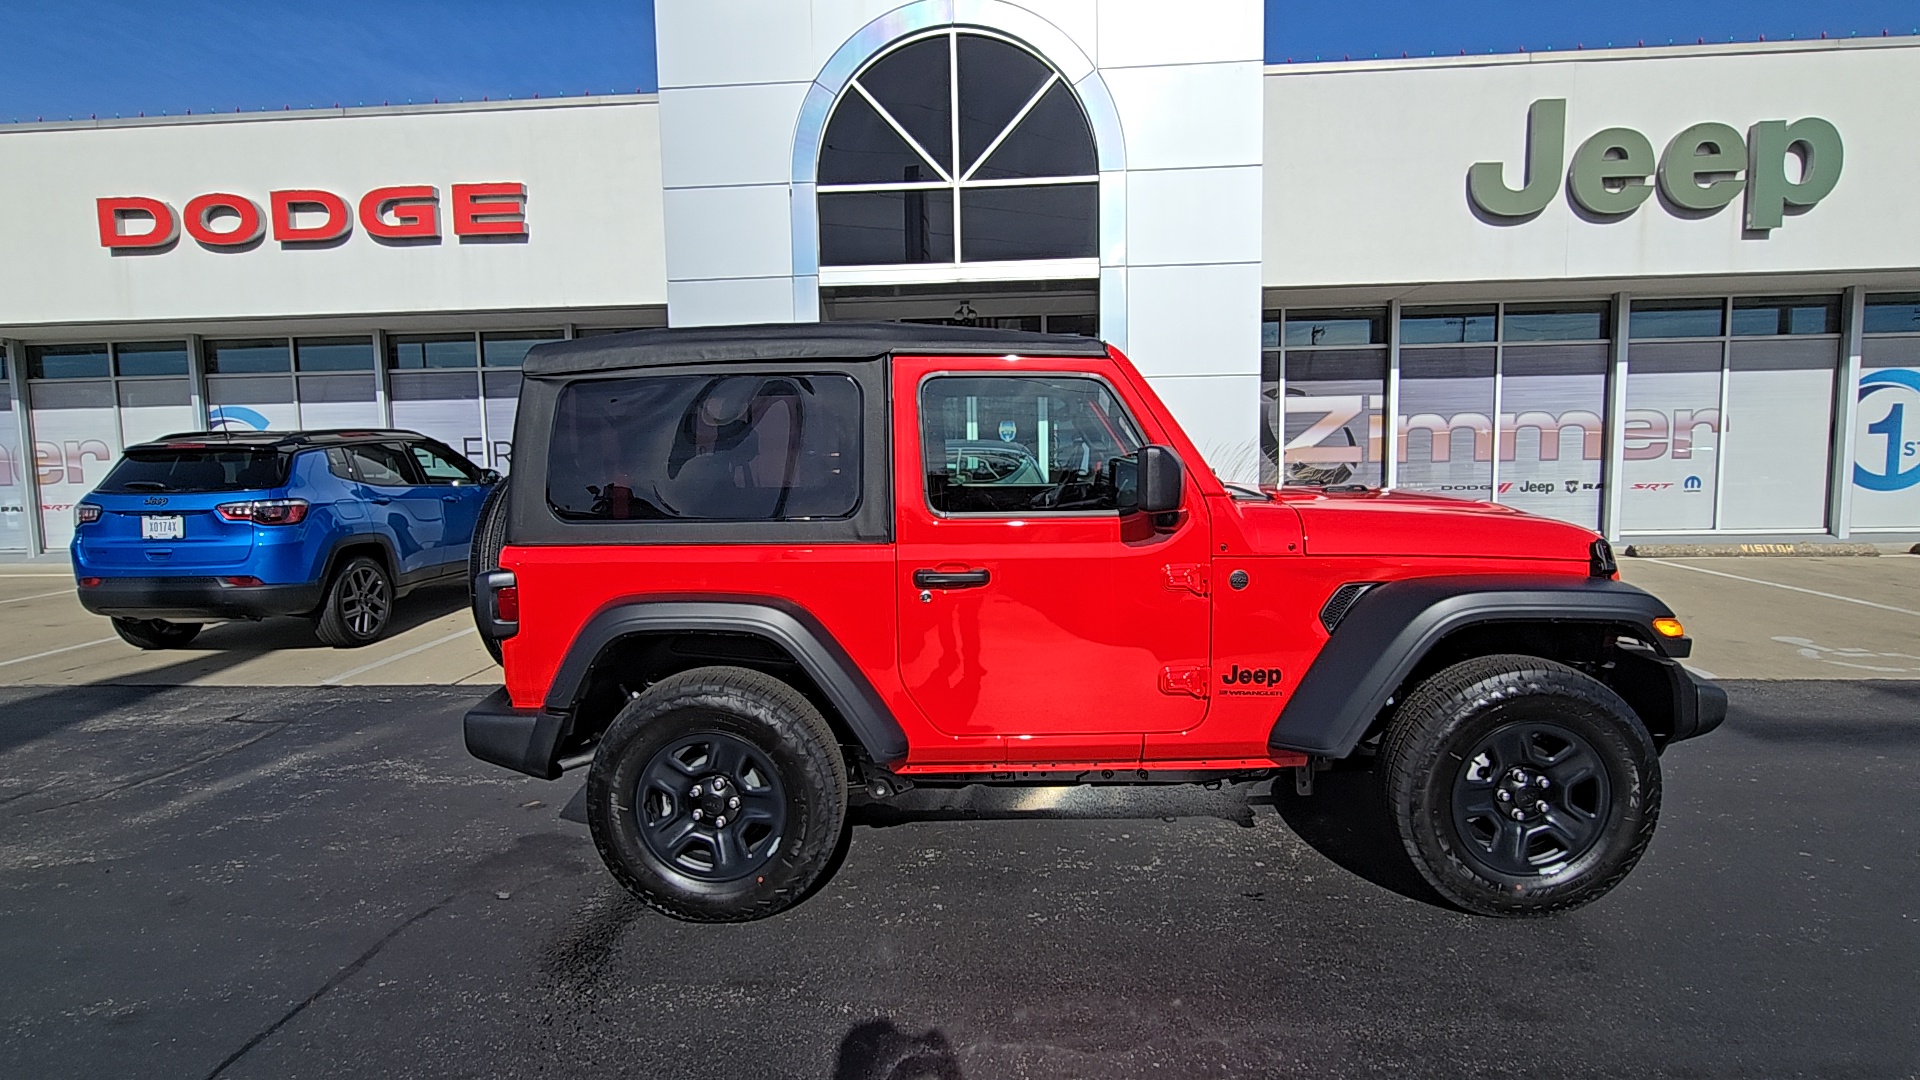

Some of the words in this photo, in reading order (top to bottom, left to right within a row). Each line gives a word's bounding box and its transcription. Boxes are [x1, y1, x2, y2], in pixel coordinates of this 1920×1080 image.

[1467, 98, 1844, 238] Jeep
[96, 182, 528, 252] DODGE
[1284, 394, 1729, 463] Zimmer
[1519, 481, 1555, 494] Jeep
[1630, 483, 1674, 491] SRT
[144, 497, 168, 505] Jeep
[1740, 543, 1796, 553] VISITOR
[1222, 665, 1282, 687] Jeep
